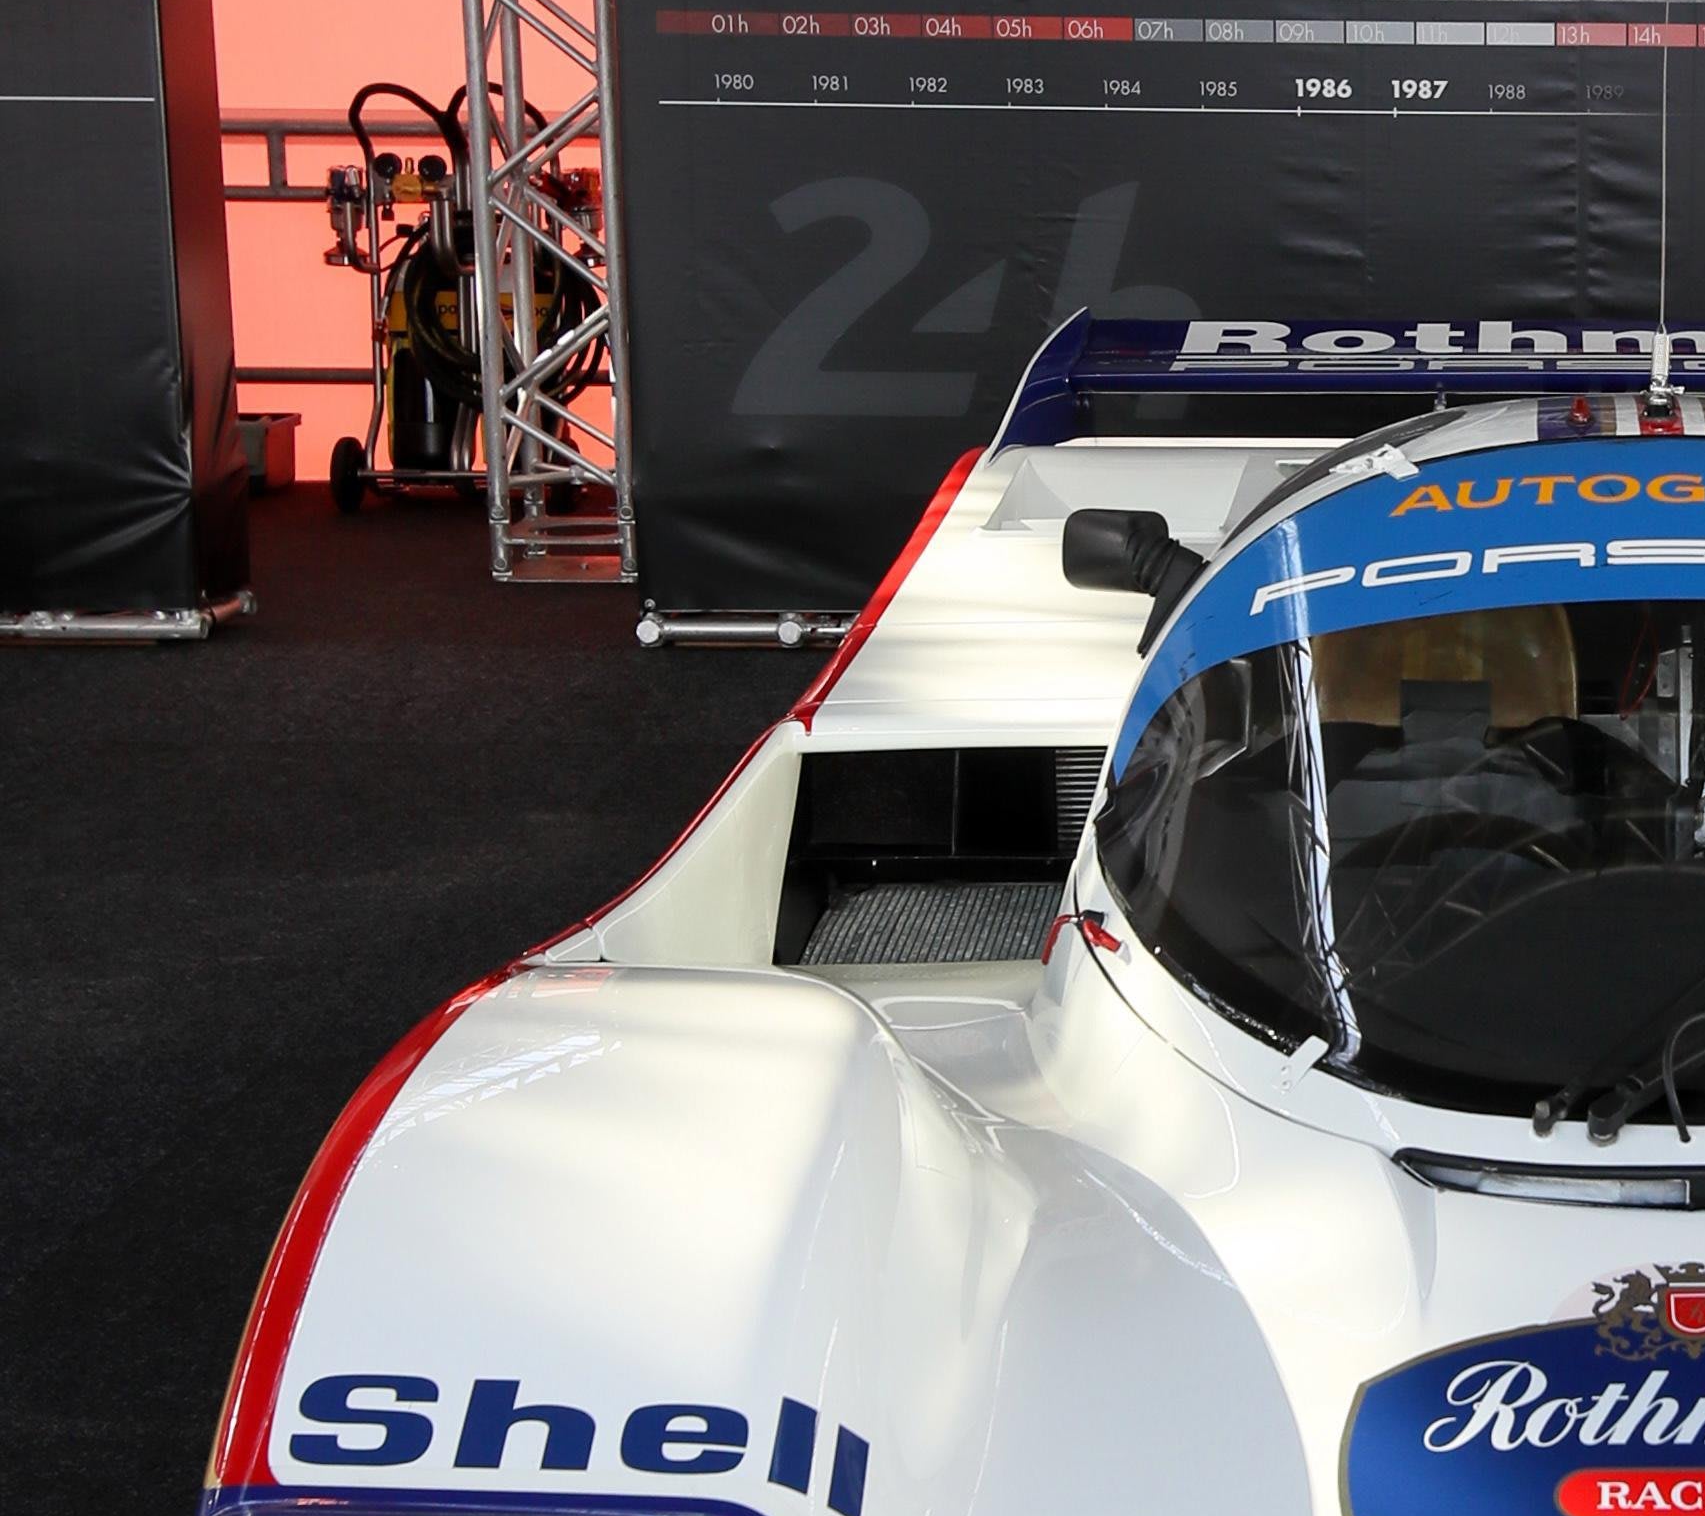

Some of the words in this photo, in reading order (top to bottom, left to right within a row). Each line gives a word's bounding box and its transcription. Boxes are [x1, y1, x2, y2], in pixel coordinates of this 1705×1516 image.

[711, 13, 749, 34] 01h
[782, 14, 820, 35] 02h
[854, 16, 891, 36] 03h
[925, 16, 962, 37] 04h
[996, 17, 1032, 38] 05h
[1068, 19, 1104, 39] 06h
[1138, 20, 1174, 40] 07h
[1207, 22, 1245, 41] 08h
[1278, 22, 1316, 42] 09h
[1351, 23, 1385, 43] 10h
[1561, 25, 1590, 45] 13h
[1634, 25, 1661, 45] 14h
[715, 73, 754, 90] 1980
[812, 75, 848, 91] 1981
[909, 77, 948, 93] 1982
[1006, 78, 1044, 94] 1983
[1103, 79, 1141, 96] 1984
[1200, 81, 1238, 97] 1985
[1295, 78, 1352, 99] 1986
[1391, 79, 1448, 99] 1987
[1488, 84, 1526, 100] 1988
[1586, 84, 1622, 99] 1989
